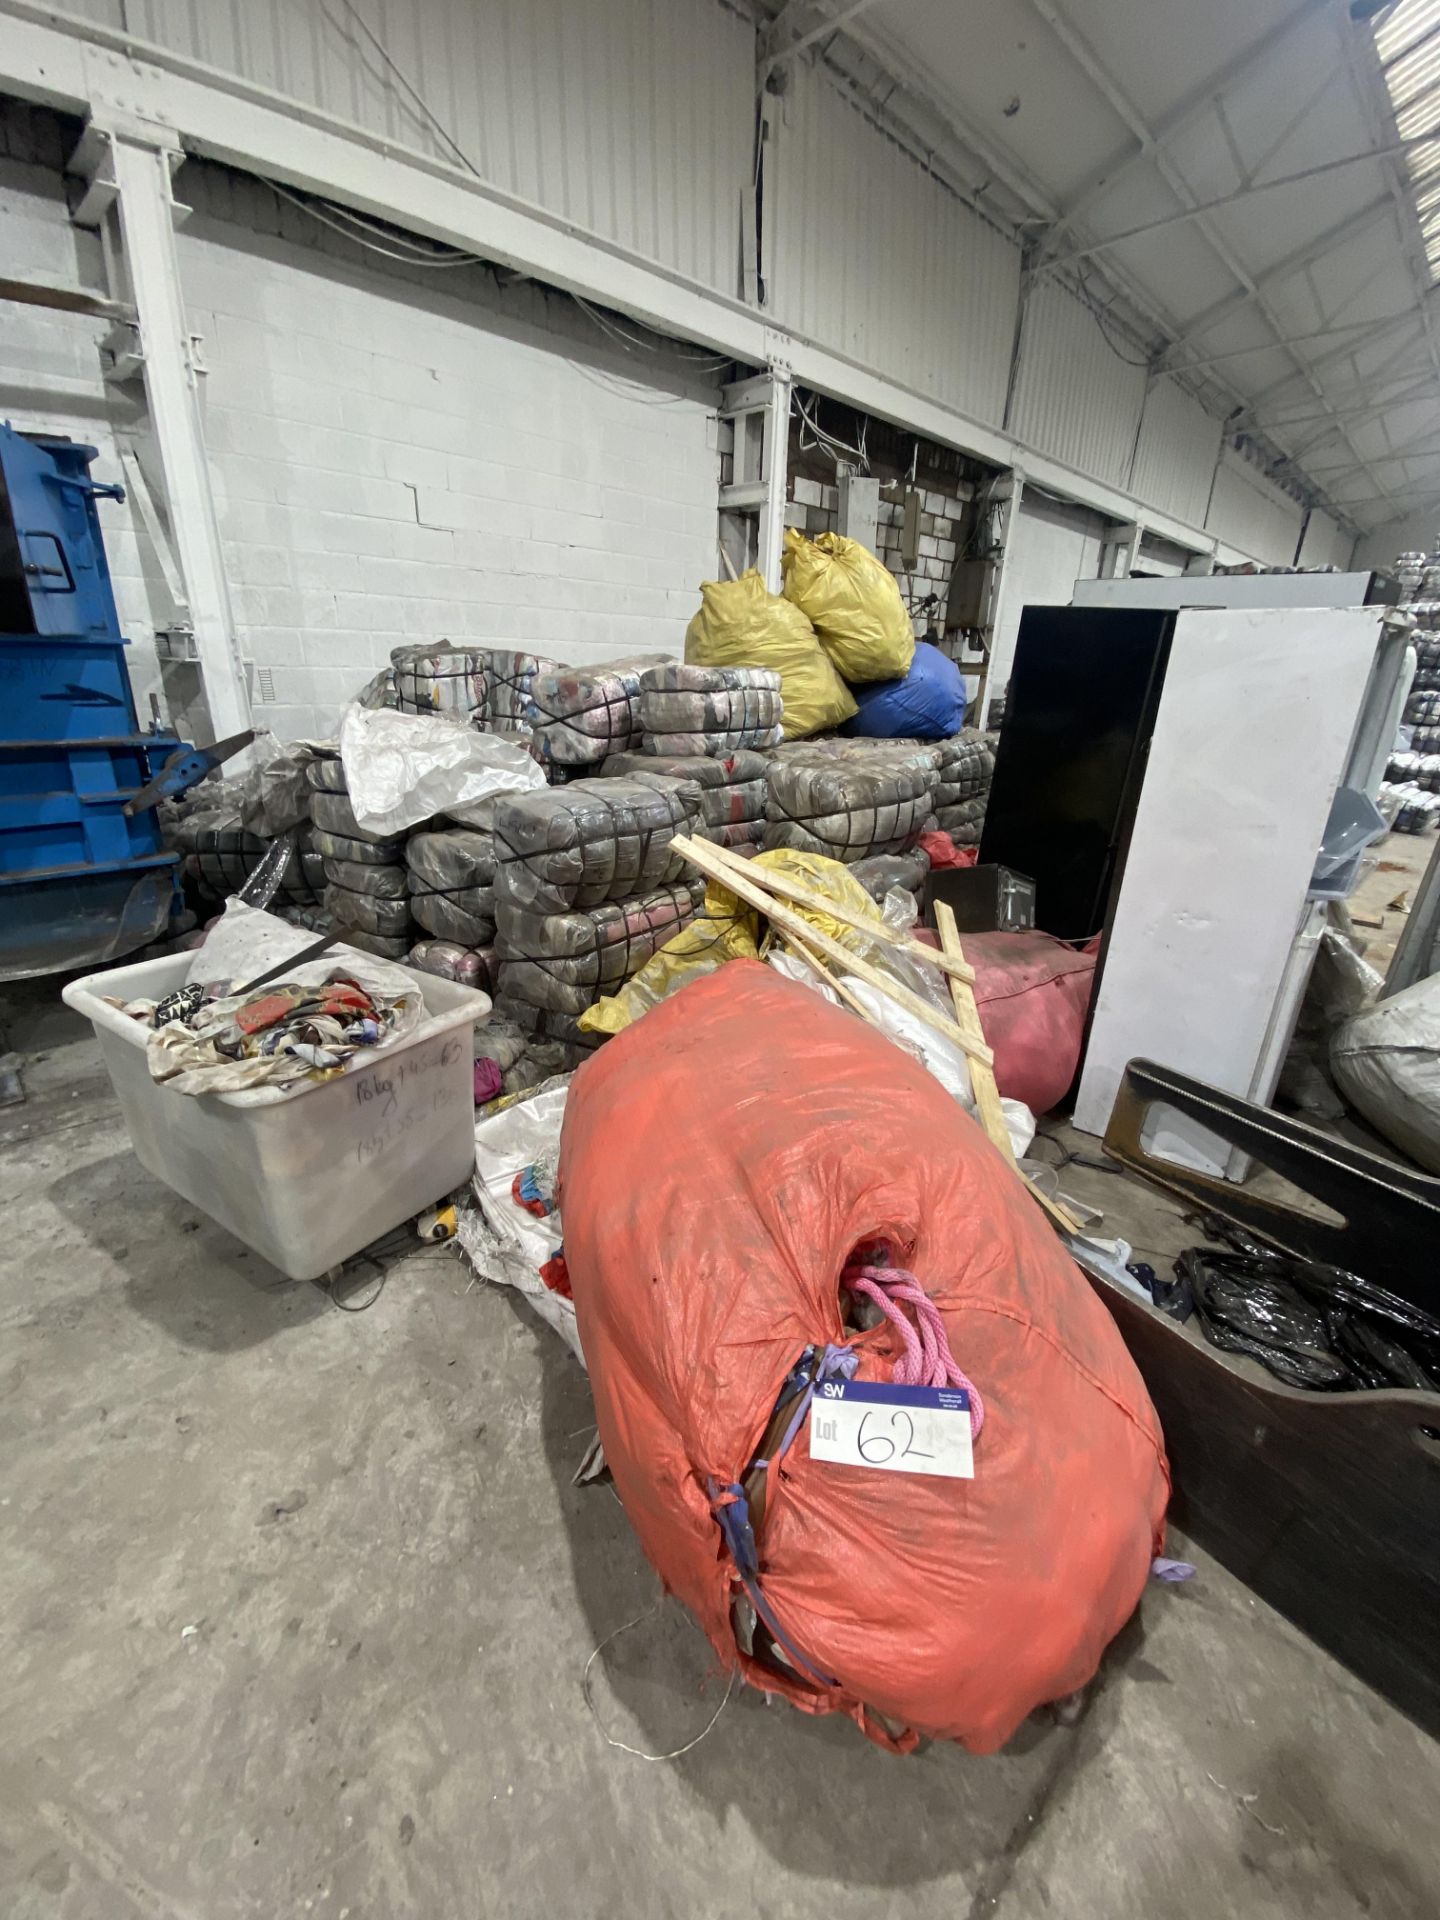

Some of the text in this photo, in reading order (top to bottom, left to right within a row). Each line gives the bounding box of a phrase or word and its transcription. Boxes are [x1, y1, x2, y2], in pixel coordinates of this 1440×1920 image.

[824, 1383, 845, 1398] SW
[815, 1411, 936, 1464] Lot 62
